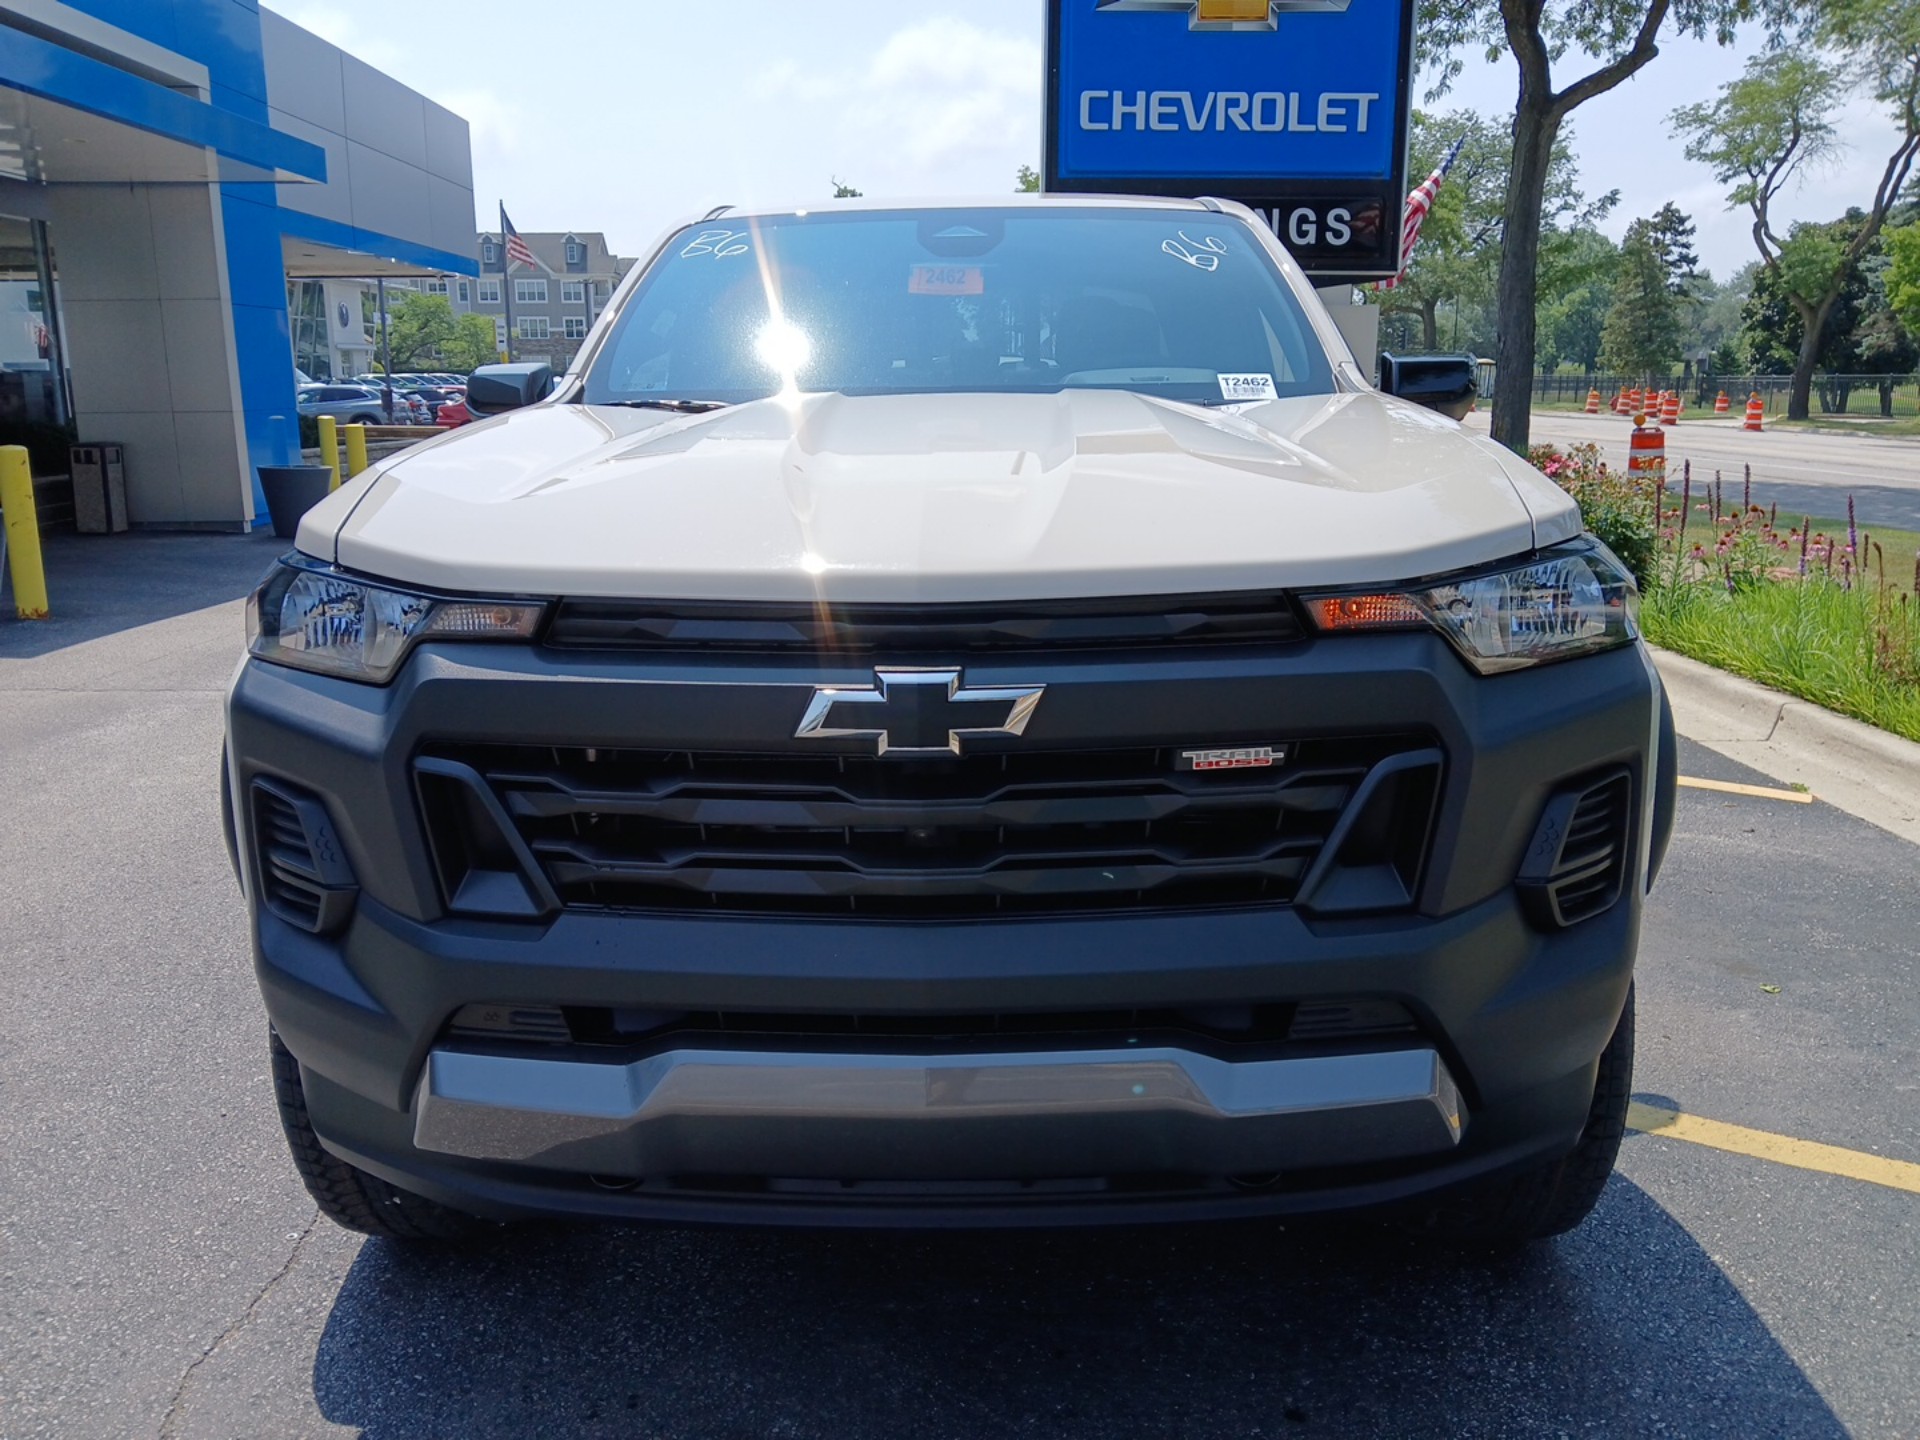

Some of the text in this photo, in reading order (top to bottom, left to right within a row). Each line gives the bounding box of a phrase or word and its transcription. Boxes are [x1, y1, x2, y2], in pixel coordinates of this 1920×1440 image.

[1080, 91, 1379, 132] CHEVROLET
[1222, 377, 1270, 386] T2462
[1182, 747, 1284, 760] TRAIL
[1193, 758, 1272, 770] BOSS
